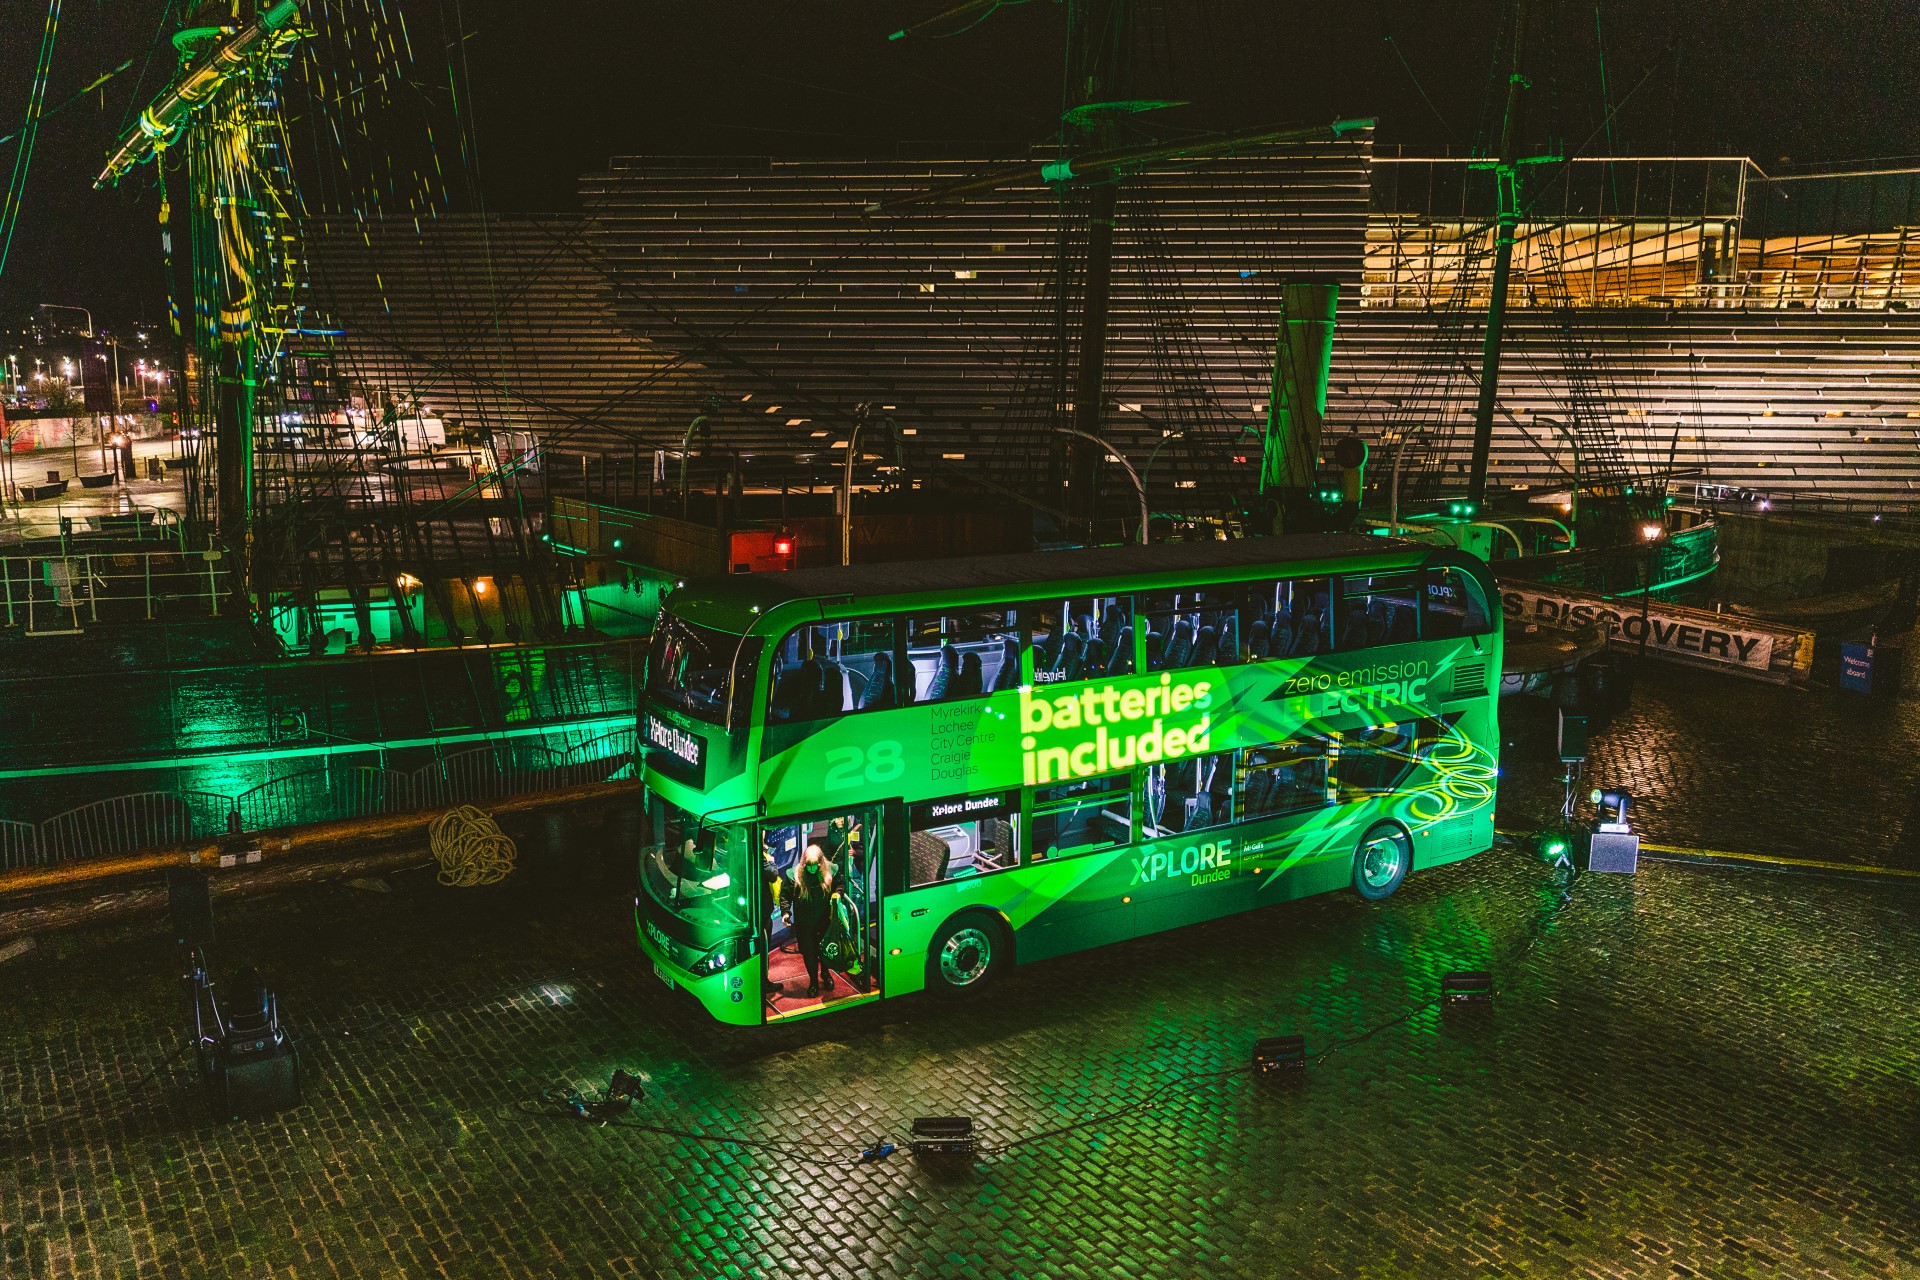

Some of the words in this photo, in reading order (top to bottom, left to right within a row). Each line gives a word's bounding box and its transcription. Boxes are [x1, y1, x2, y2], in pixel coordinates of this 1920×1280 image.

[1535, 598, 1759, 661] DISCOVERY
[1843, 656, 1870, 668] Welcome
[1284, 674, 1331, 695] zero
[1337, 660, 1428, 686] emission
[1846, 668, 1866, 678] aboard
[1019, 672, 1212, 734] batteries
[1283, 677, 1428, 722] ELECTRIC
[931, 703, 981, 720] Myrekirk
[931, 720, 974, 735] Lochee
[649, 715, 673, 751] Xplore
[673, 728, 699, 766] Dundee
[930, 737, 955, 750] City
[956, 732, 996, 747] Centre
[1021, 711, 1211, 786] included
[824, 740, 905, 791] 28
[930, 751, 971, 766] Craigie
[931, 764, 978, 781] Douglas
[932, 804, 962, 817] Xplore
[965, 797, 999, 811] Dundee
[1130, 839, 1231, 886] XPLORE
[1191, 868, 1231, 887] Dundee
